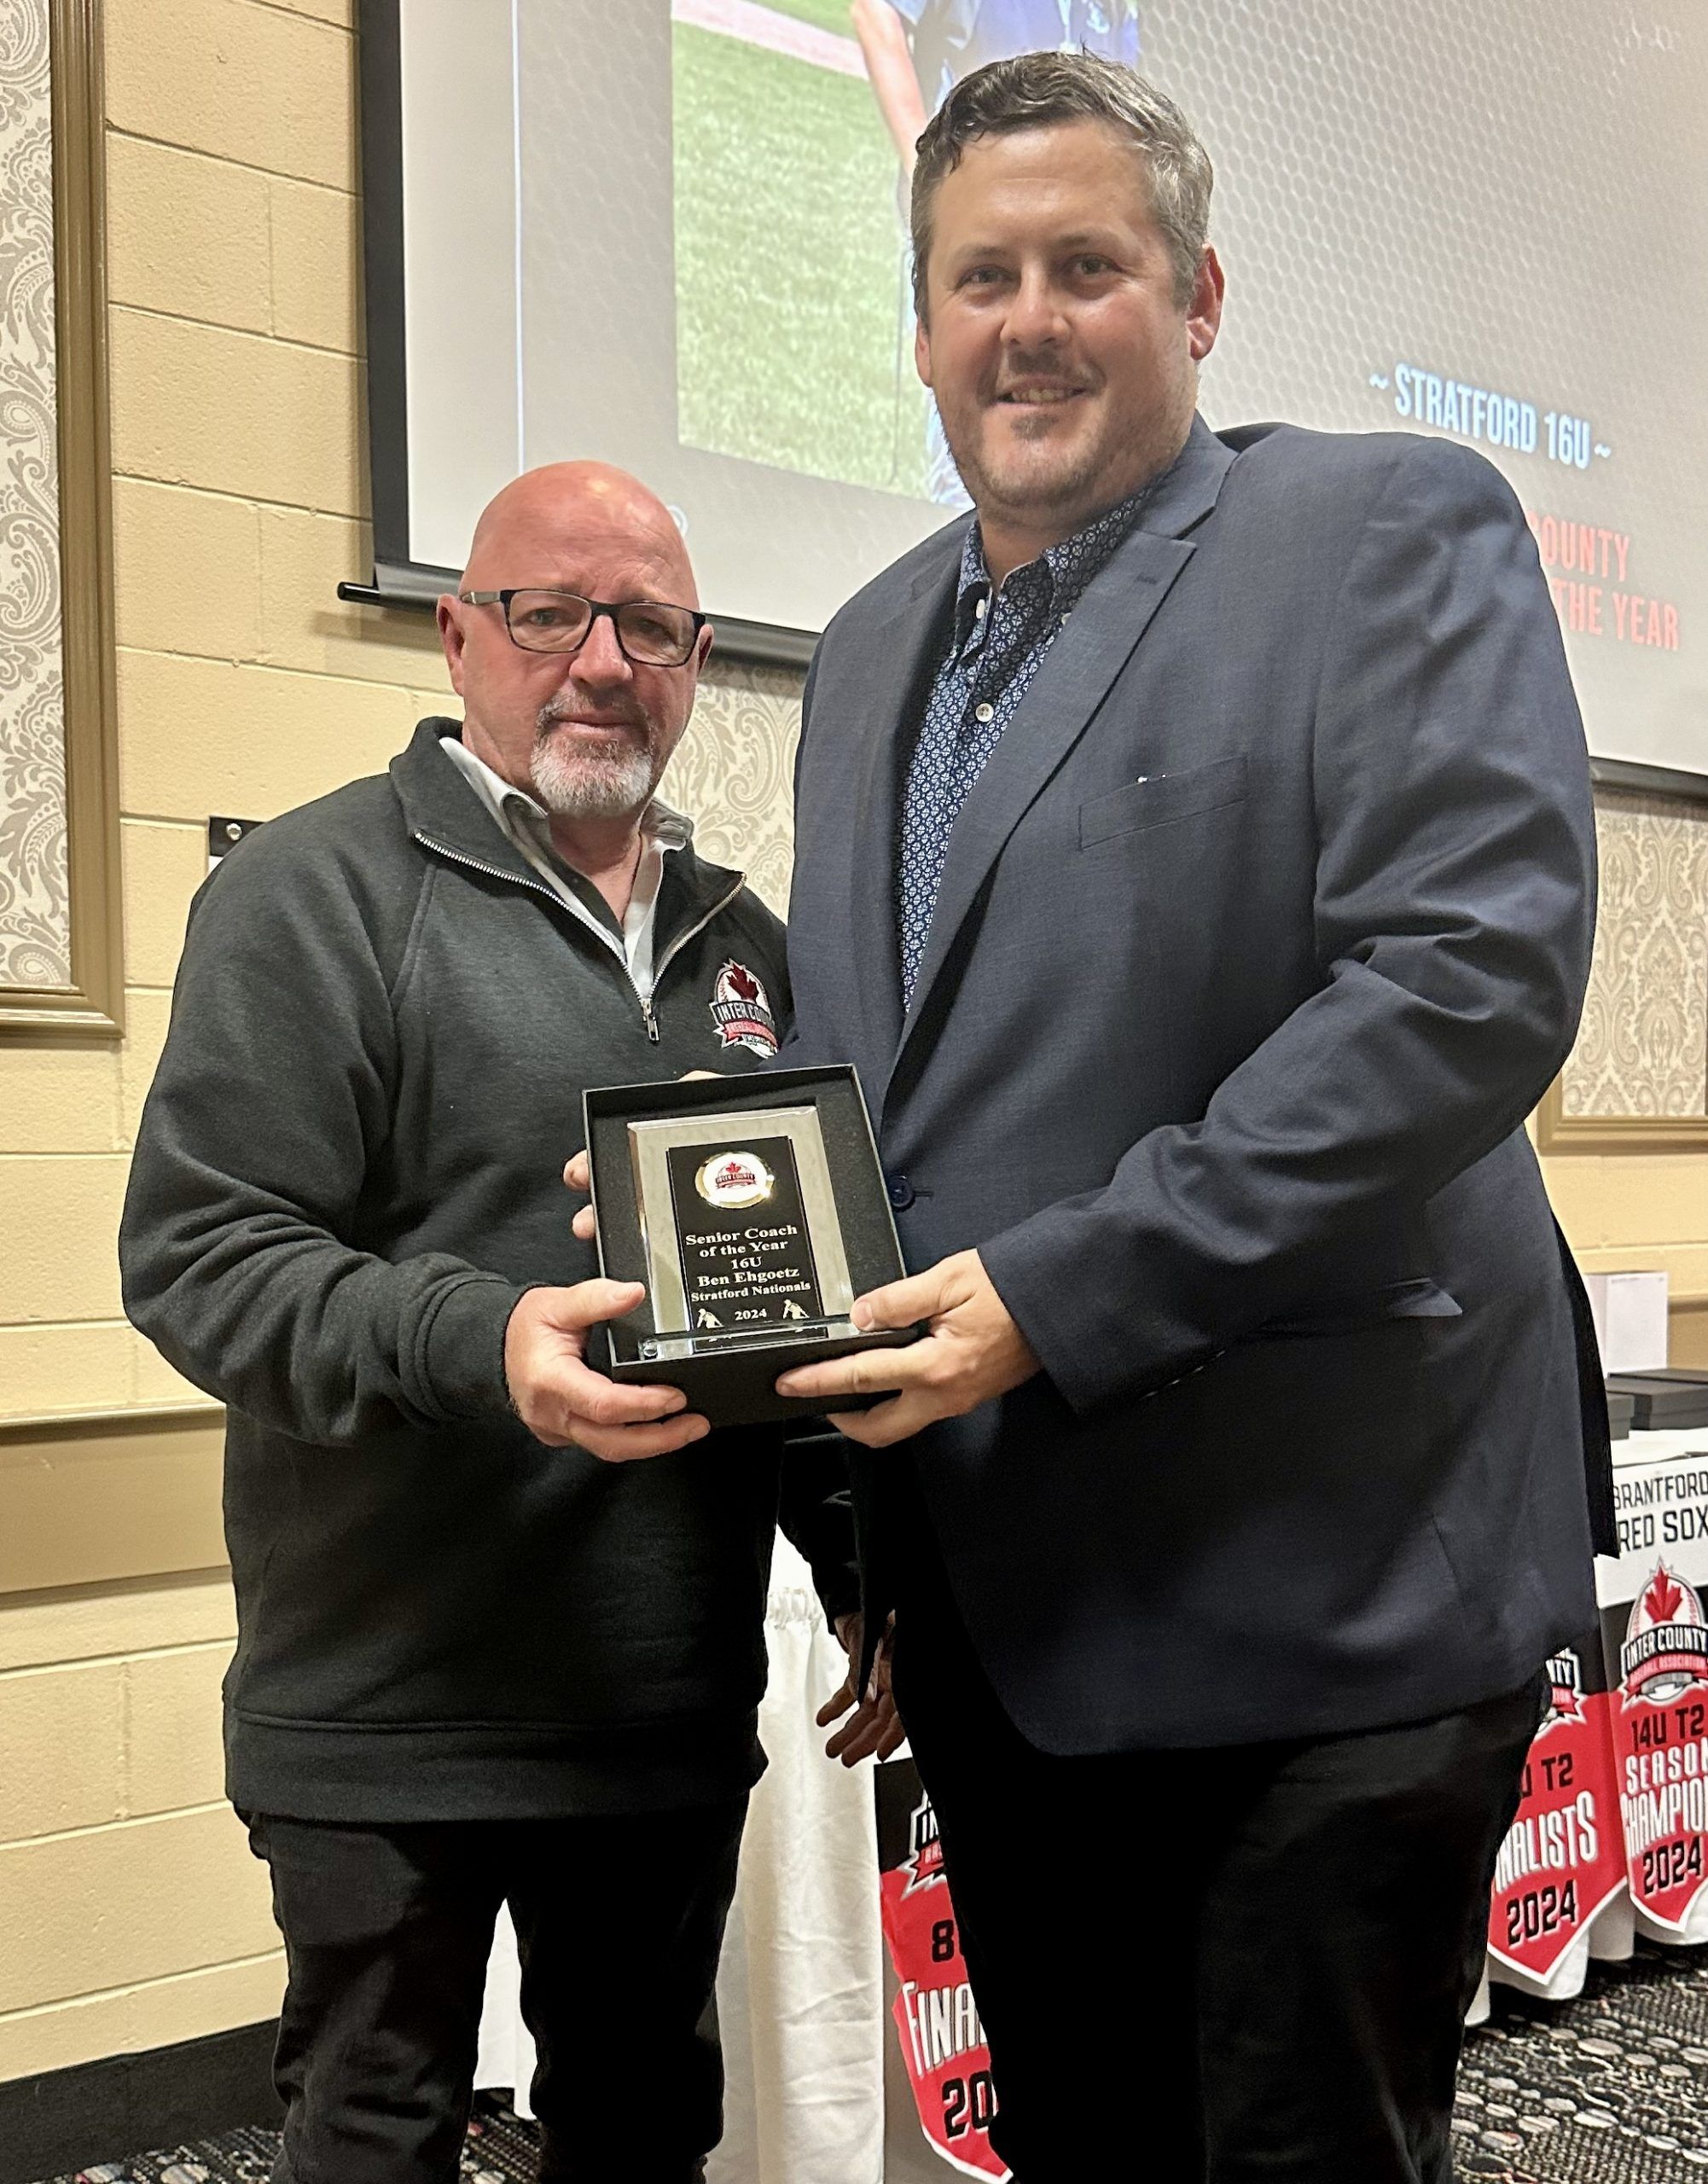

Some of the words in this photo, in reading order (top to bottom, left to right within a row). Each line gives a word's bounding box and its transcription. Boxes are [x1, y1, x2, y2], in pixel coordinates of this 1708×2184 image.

[1612, 591, 1679, 652] YEAR
[685, 1232, 741, 1246] Senior
[744, 1224, 798, 1240] Coach
[699, 1246, 717, 1258] of
[720, 1244, 747, 1256] the
[749, 1240, 788, 1252] Year
[697, 1275, 729, 1287] Ben
[734, 1268, 800, 1283] Ehgoetz
[730, 1256, 763, 1269] 16U
[690, 1287, 749, 1302] Stratford
[752, 1281, 811, 1295] Nationals
[734, 1308, 767, 1321] 2024
[1613, 1471, 1708, 1511] BRANTFORD
[1617, 1513, 1654, 1552] RED
[1663, 1504, 1708, 1543] SOX
[1626, 1630, 1656, 1672] INTER
[1657, 1626, 1707, 1652] COUNTY
[1632, 1712, 1666, 1751] 14U
[1676, 1704, 1705, 1739] T2
[1541, 1752, 1573, 1791] T2
[1495, 1790, 1599, 1894] INALISTS
[1643, 1835, 1703, 1896] 2024
[1507, 1879, 1579, 1949] 2024
